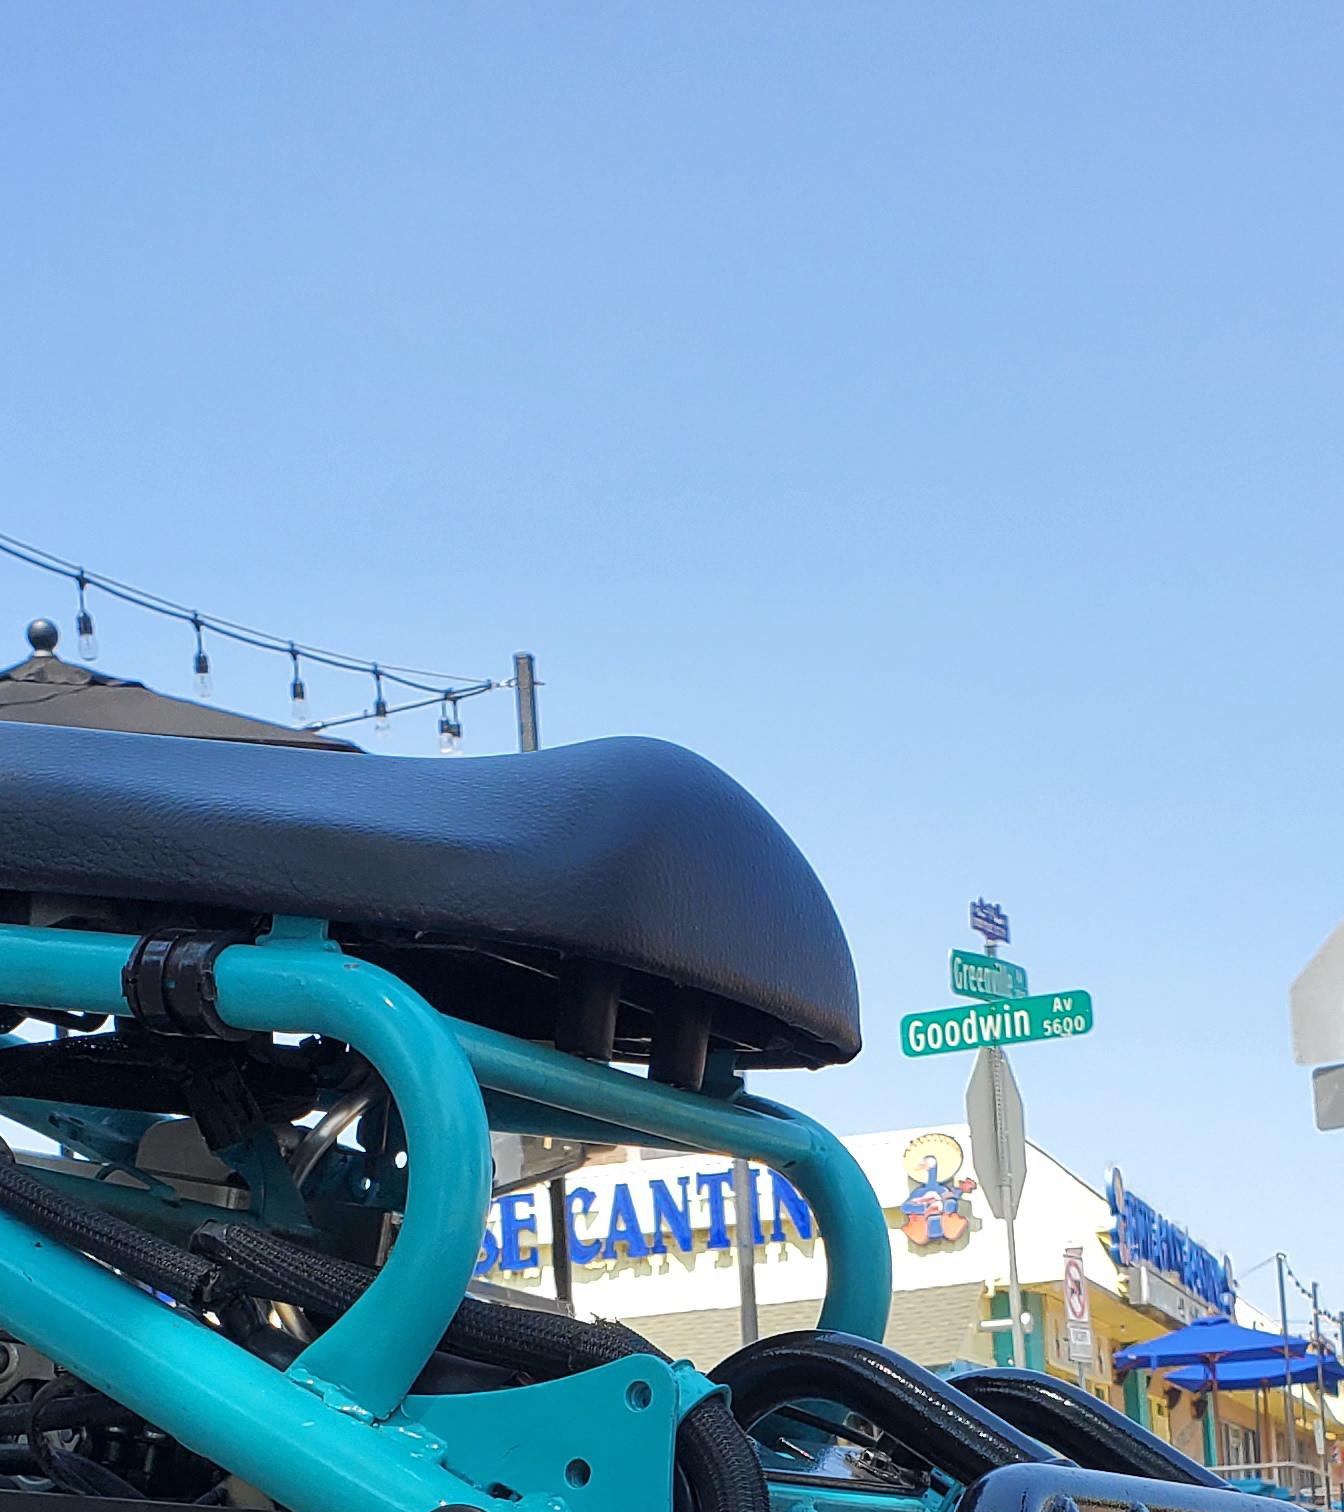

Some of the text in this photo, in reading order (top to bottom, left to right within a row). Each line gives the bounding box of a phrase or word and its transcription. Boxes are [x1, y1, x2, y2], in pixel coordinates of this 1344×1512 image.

[953, 956, 1013, 999] Greene
[1052, 997, 1073, 1012] Av
[909, 1004, 1030, 1052] Goodwin
[1043, 1015, 1086, 1036] 5600
